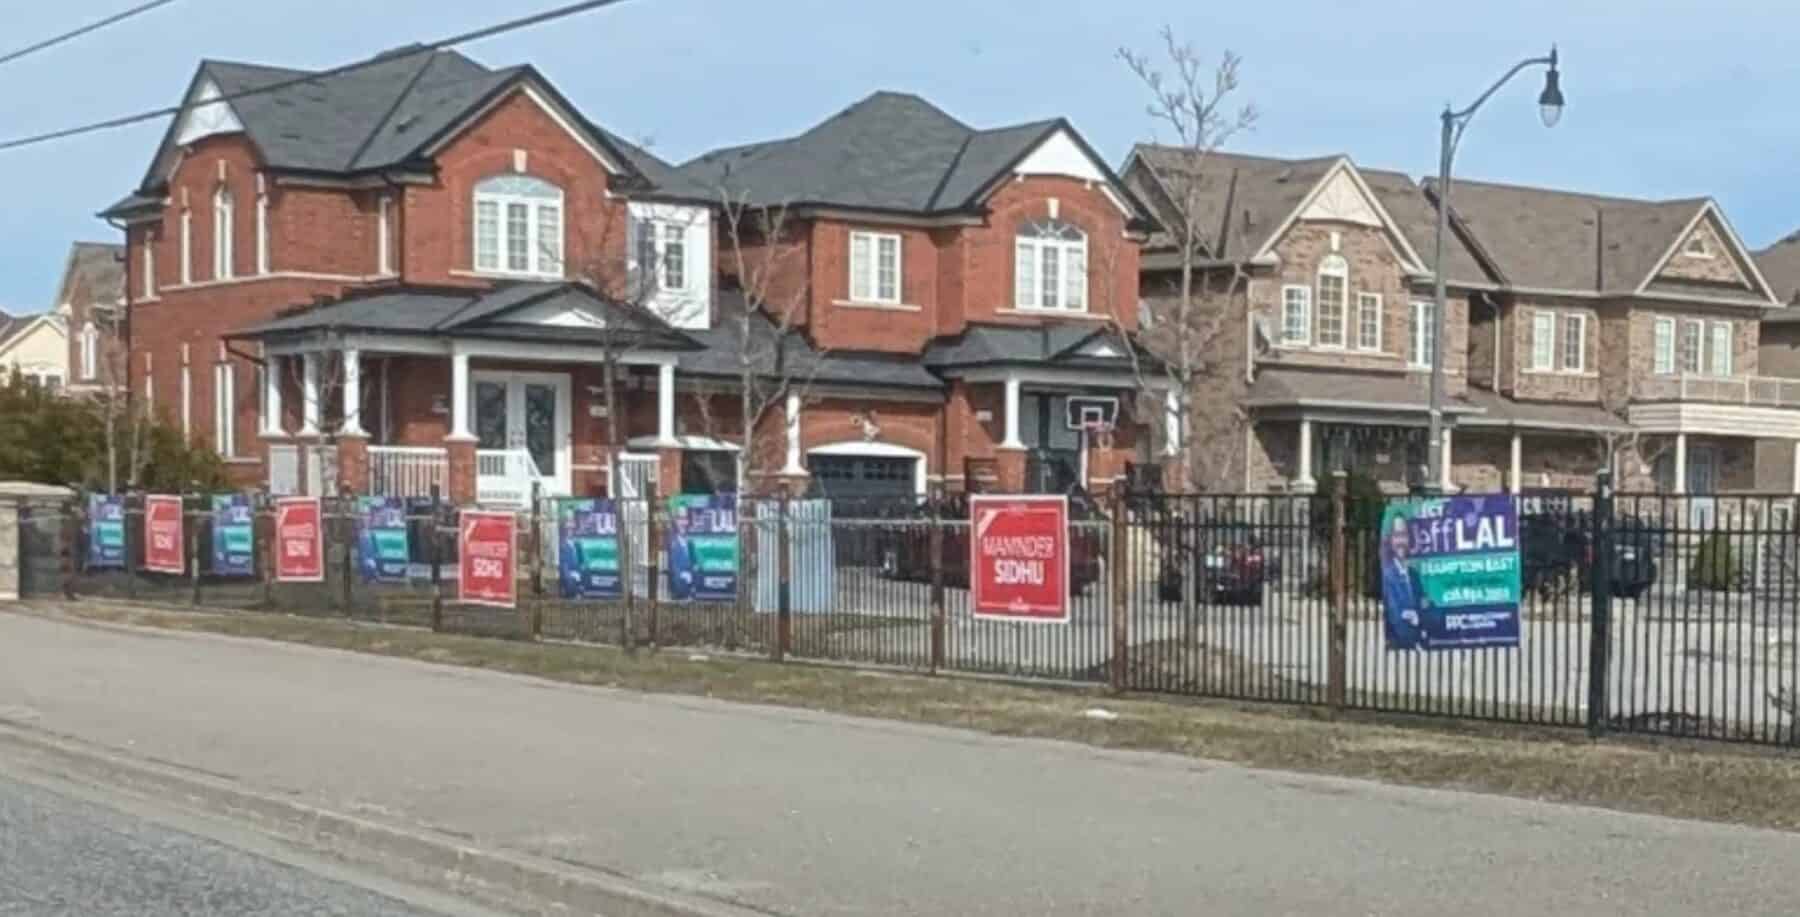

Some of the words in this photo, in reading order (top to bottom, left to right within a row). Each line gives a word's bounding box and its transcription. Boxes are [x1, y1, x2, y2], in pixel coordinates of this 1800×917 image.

[1409, 518, 1454, 554] Jeff
[1455, 516, 1514, 550] LAL
[994, 559, 1045, 585] SIDHU
